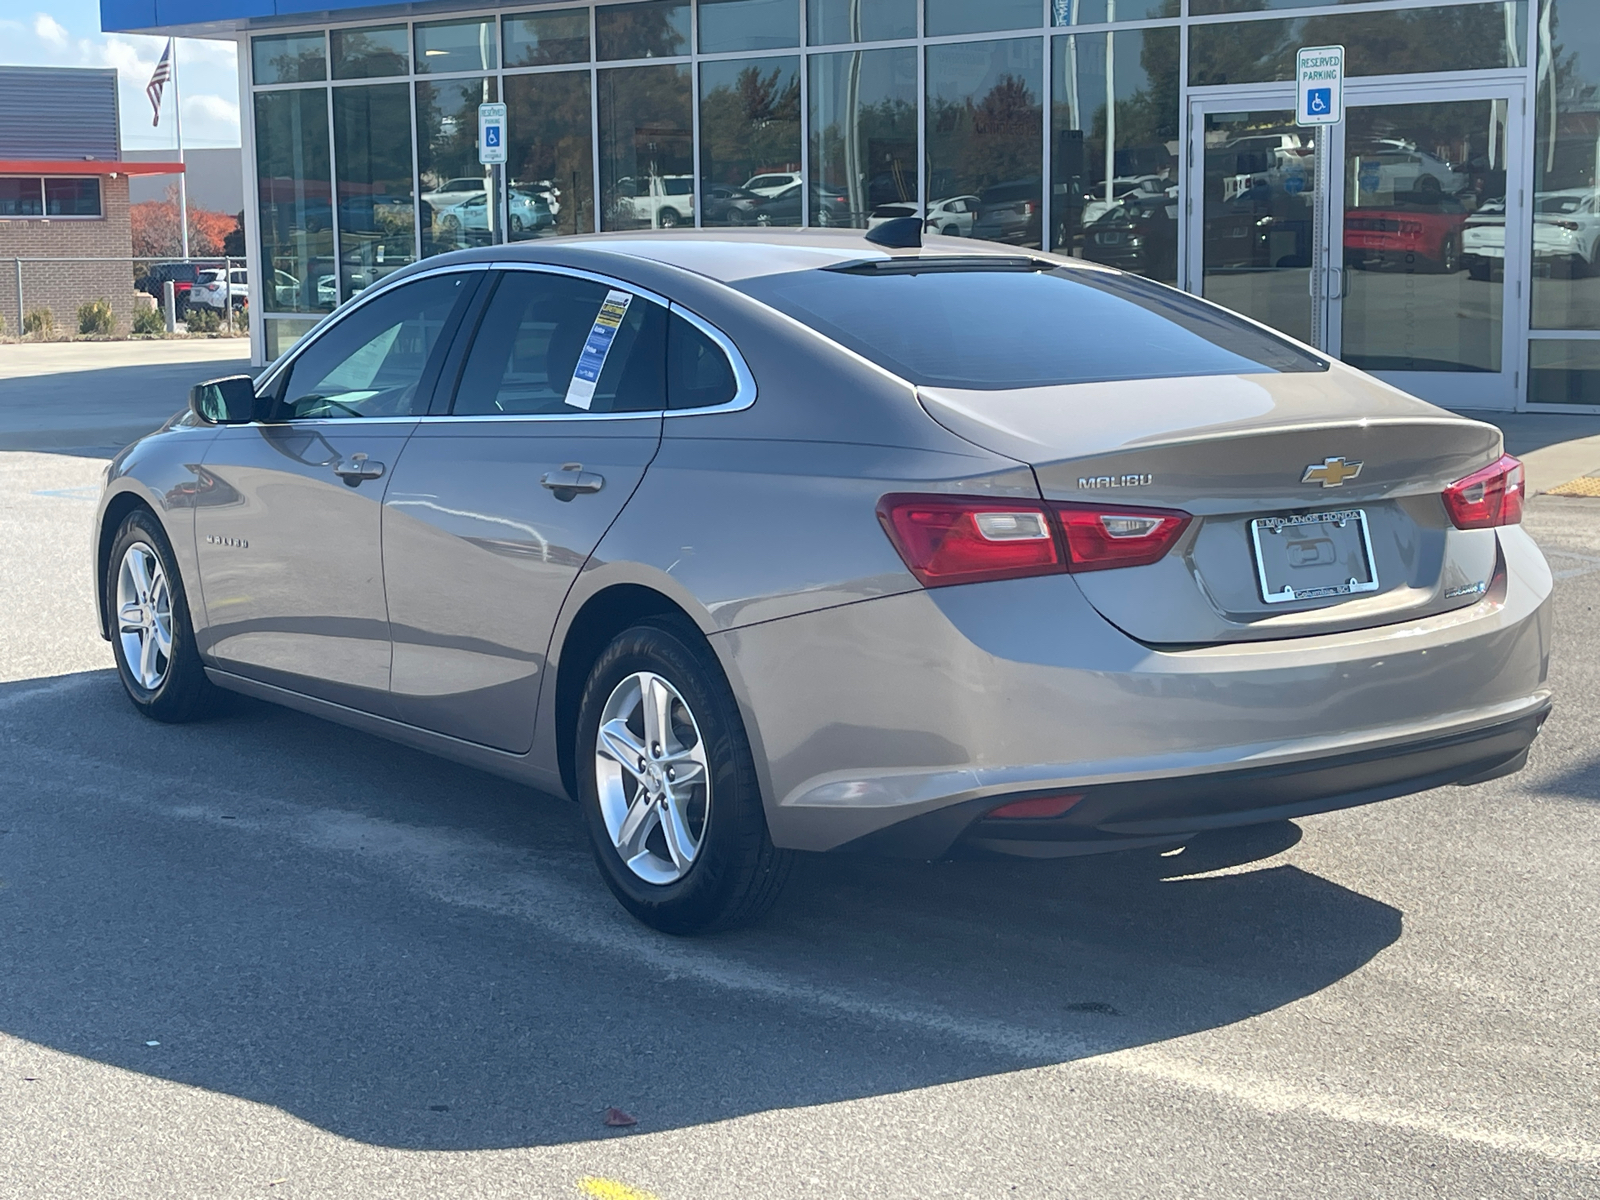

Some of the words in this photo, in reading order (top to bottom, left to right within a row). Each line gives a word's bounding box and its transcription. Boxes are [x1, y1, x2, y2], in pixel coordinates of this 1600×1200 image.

[1301, 56, 1340, 68] RESERVED
[1302, 69, 1337, 81] PARKING
[1077, 473, 1153, 489] MALIBU
[1265, 513, 1321, 527] MIDLANDS
[1322, 511, 1360, 521] HONDA
[206, 534, 249, 548] MALIBU
[1337, 586, 1350, 594] SC
